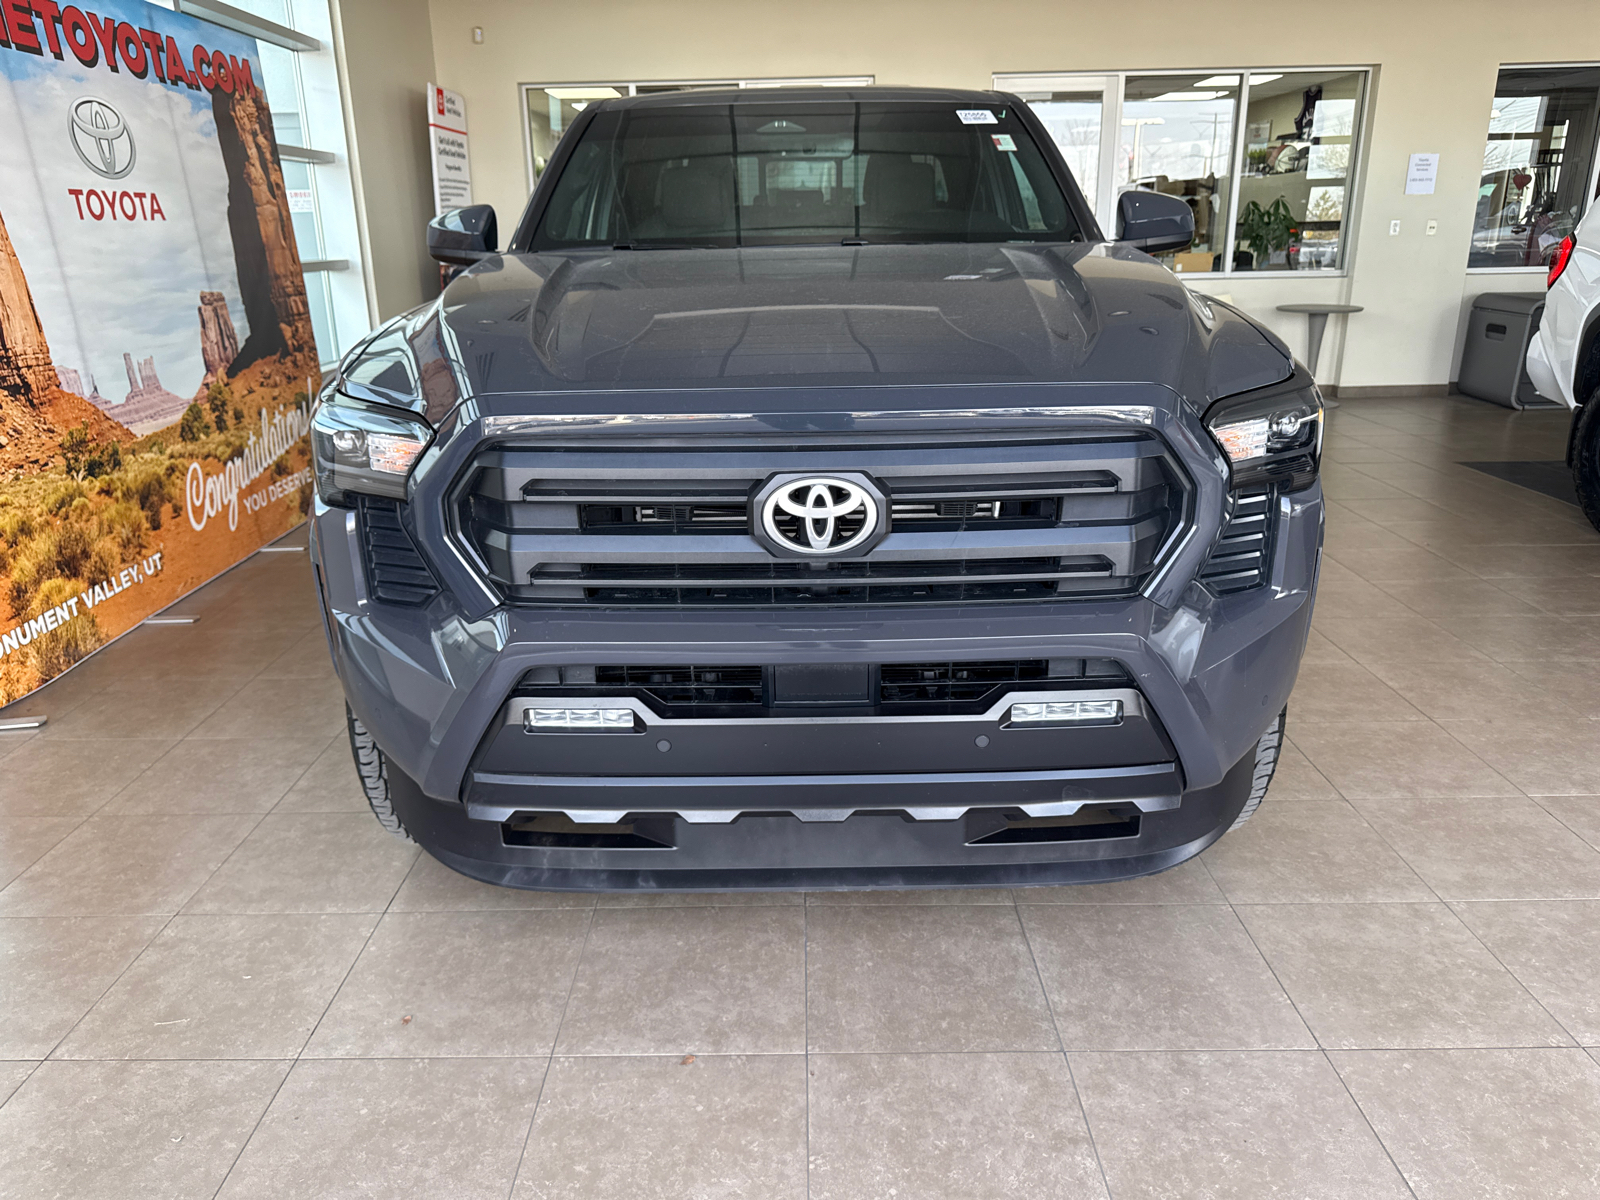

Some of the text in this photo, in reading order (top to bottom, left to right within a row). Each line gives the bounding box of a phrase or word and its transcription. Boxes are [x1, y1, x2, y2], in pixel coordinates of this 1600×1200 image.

[0, 0, 257, 99] ETOYOTA.COM
[68, 188, 166, 221] TOYOTA
[243, 466, 313, 515] YOU DESERVE
[0, 552, 162, 660] NUMENT VALLEY, UT
